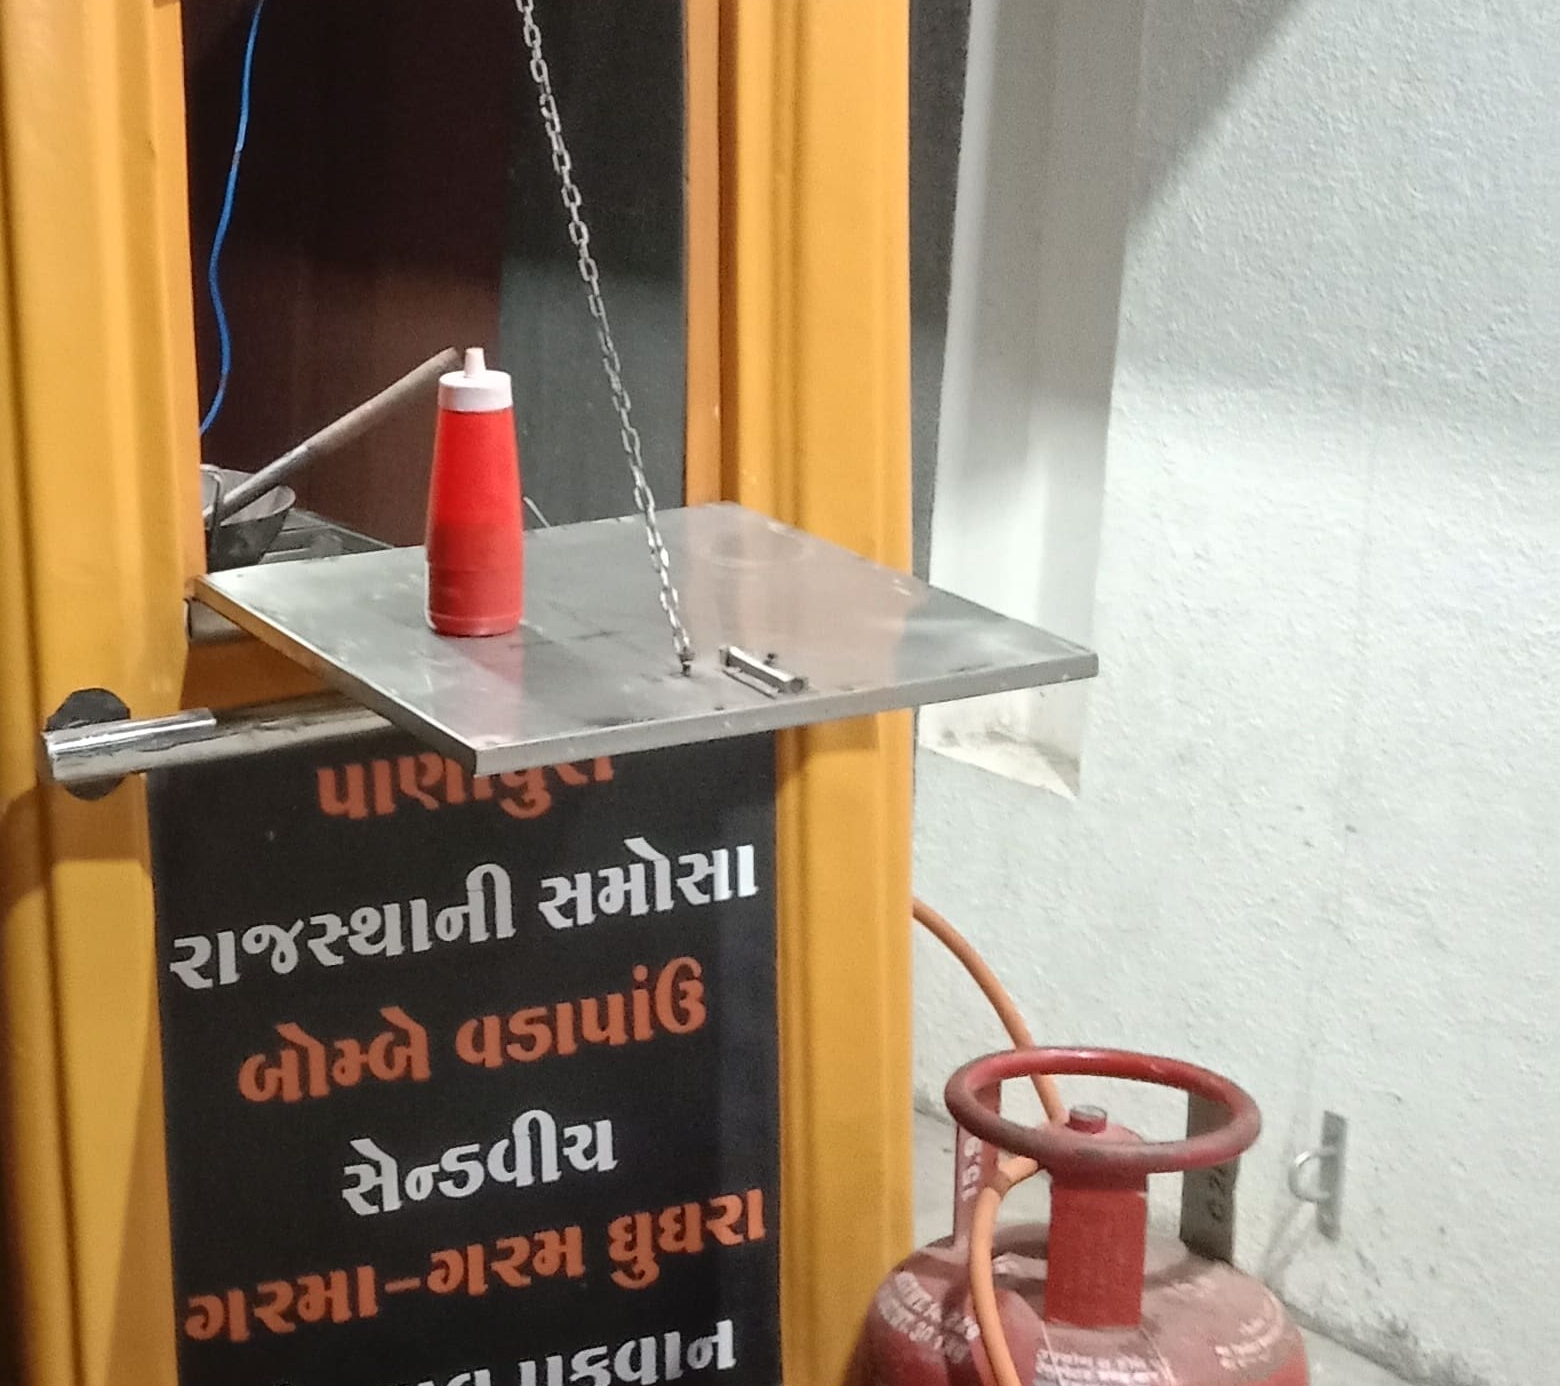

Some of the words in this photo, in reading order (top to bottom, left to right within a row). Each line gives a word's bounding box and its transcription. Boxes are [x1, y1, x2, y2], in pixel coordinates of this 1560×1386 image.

[169, 862, 516, 989] રાજસ્થાની
[539, 837, 759, 929] સમોસા
[239, 1005, 431, 1102] બોમ્બે
[455, 956, 706, 1067] વડાપાંઉ
[341, 1110, 619, 1215] સેન્ડવીચ
